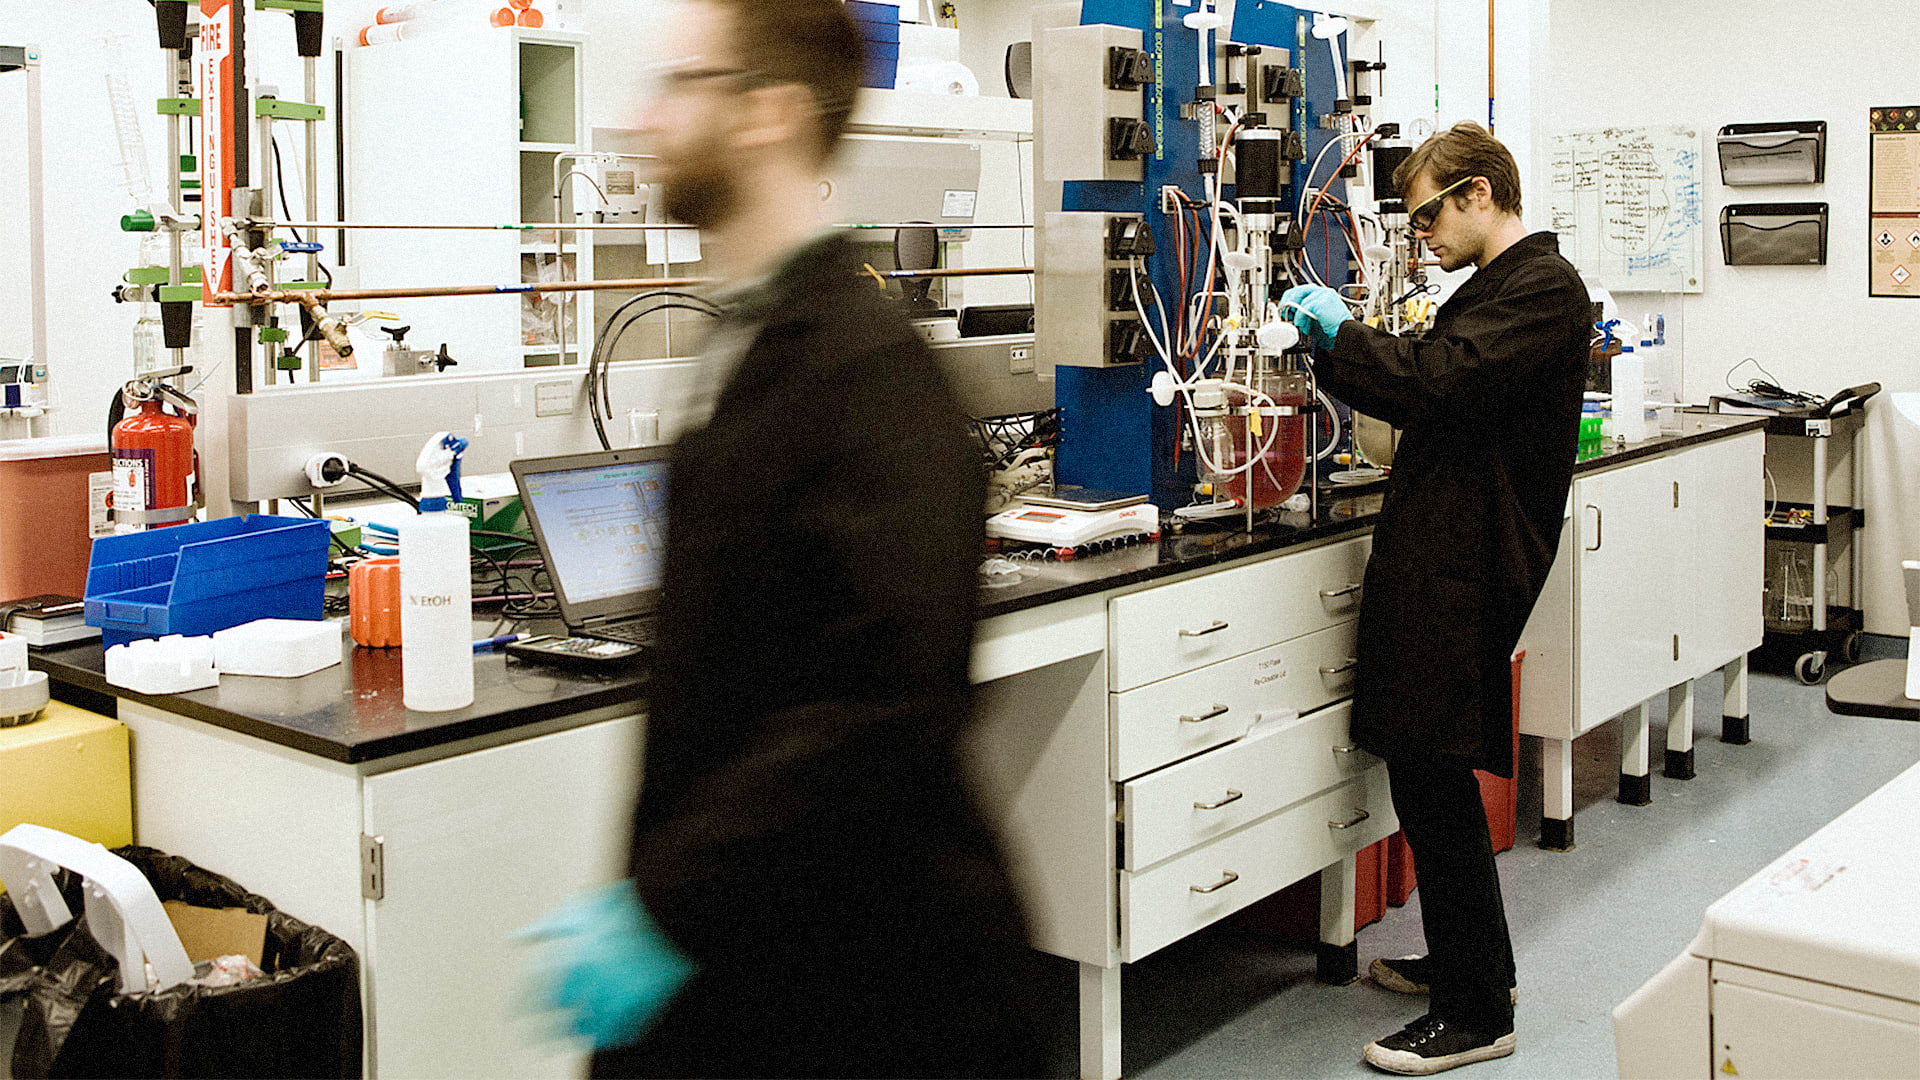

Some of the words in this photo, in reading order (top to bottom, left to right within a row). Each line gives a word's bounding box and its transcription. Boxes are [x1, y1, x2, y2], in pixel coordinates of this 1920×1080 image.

[200, 22, 222, 52] FIRE
[208, 58, 217, 283] EXTINGUISHER
[421, 595, 451, 607] EtOH
